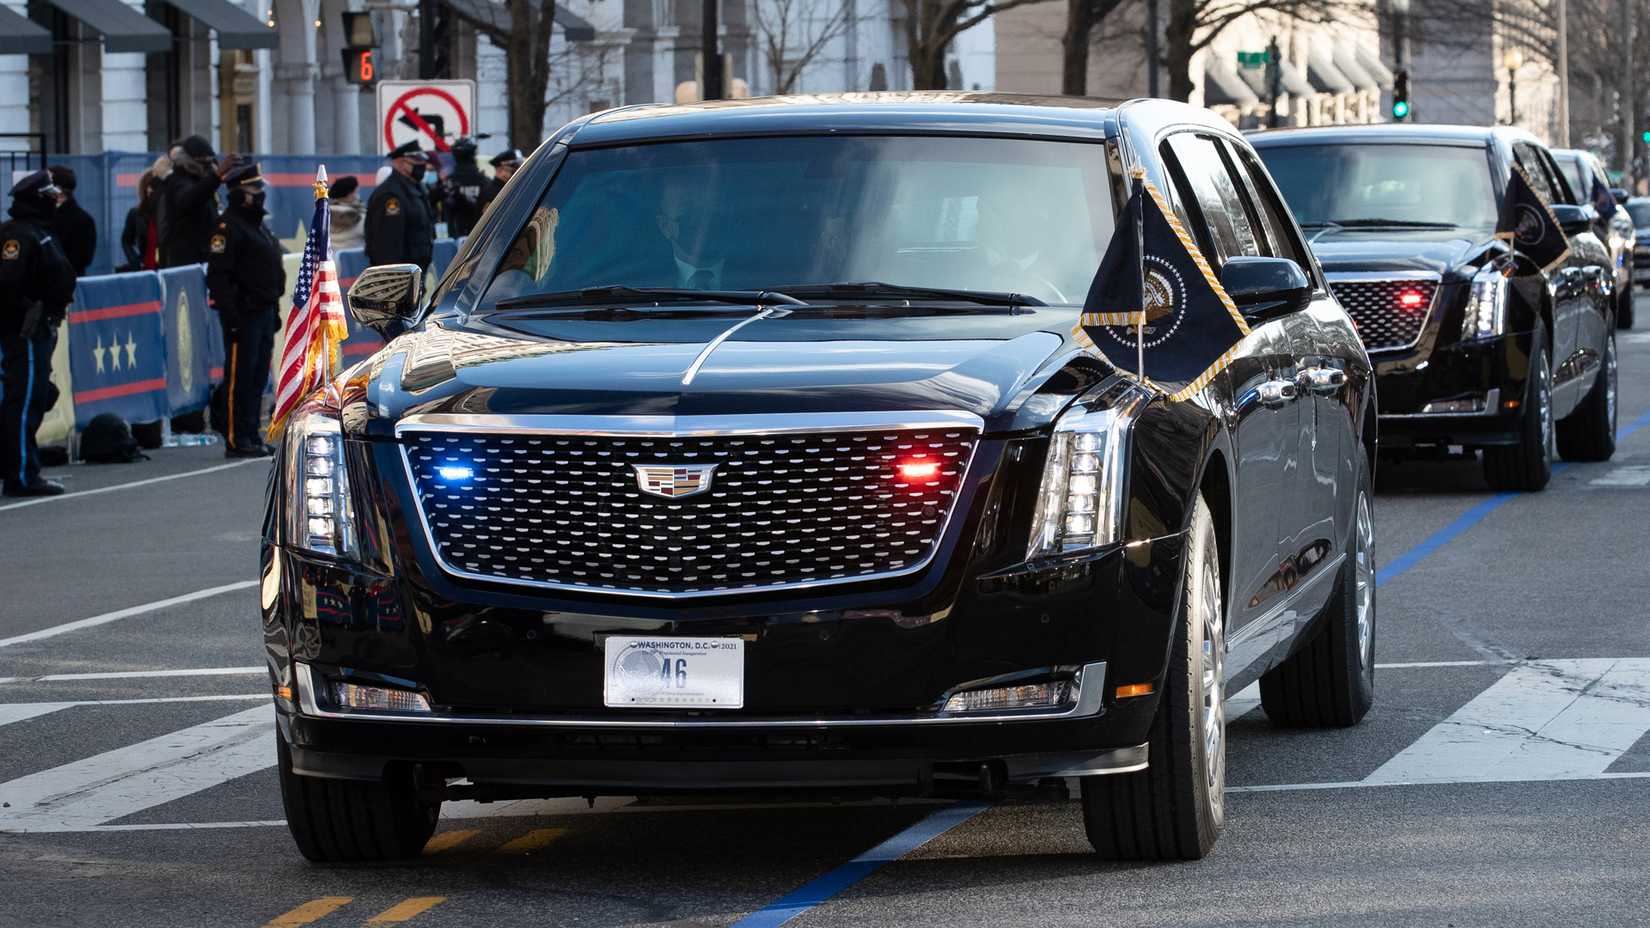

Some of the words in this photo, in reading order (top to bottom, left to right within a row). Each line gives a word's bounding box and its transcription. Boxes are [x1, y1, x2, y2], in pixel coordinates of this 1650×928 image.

[361, 51, 373, 81] 6
[638, 641, 694, 650] WASHINGTON,
[695, 641, 711, 650] D.C.
[661, 658, 687, 689] 46
